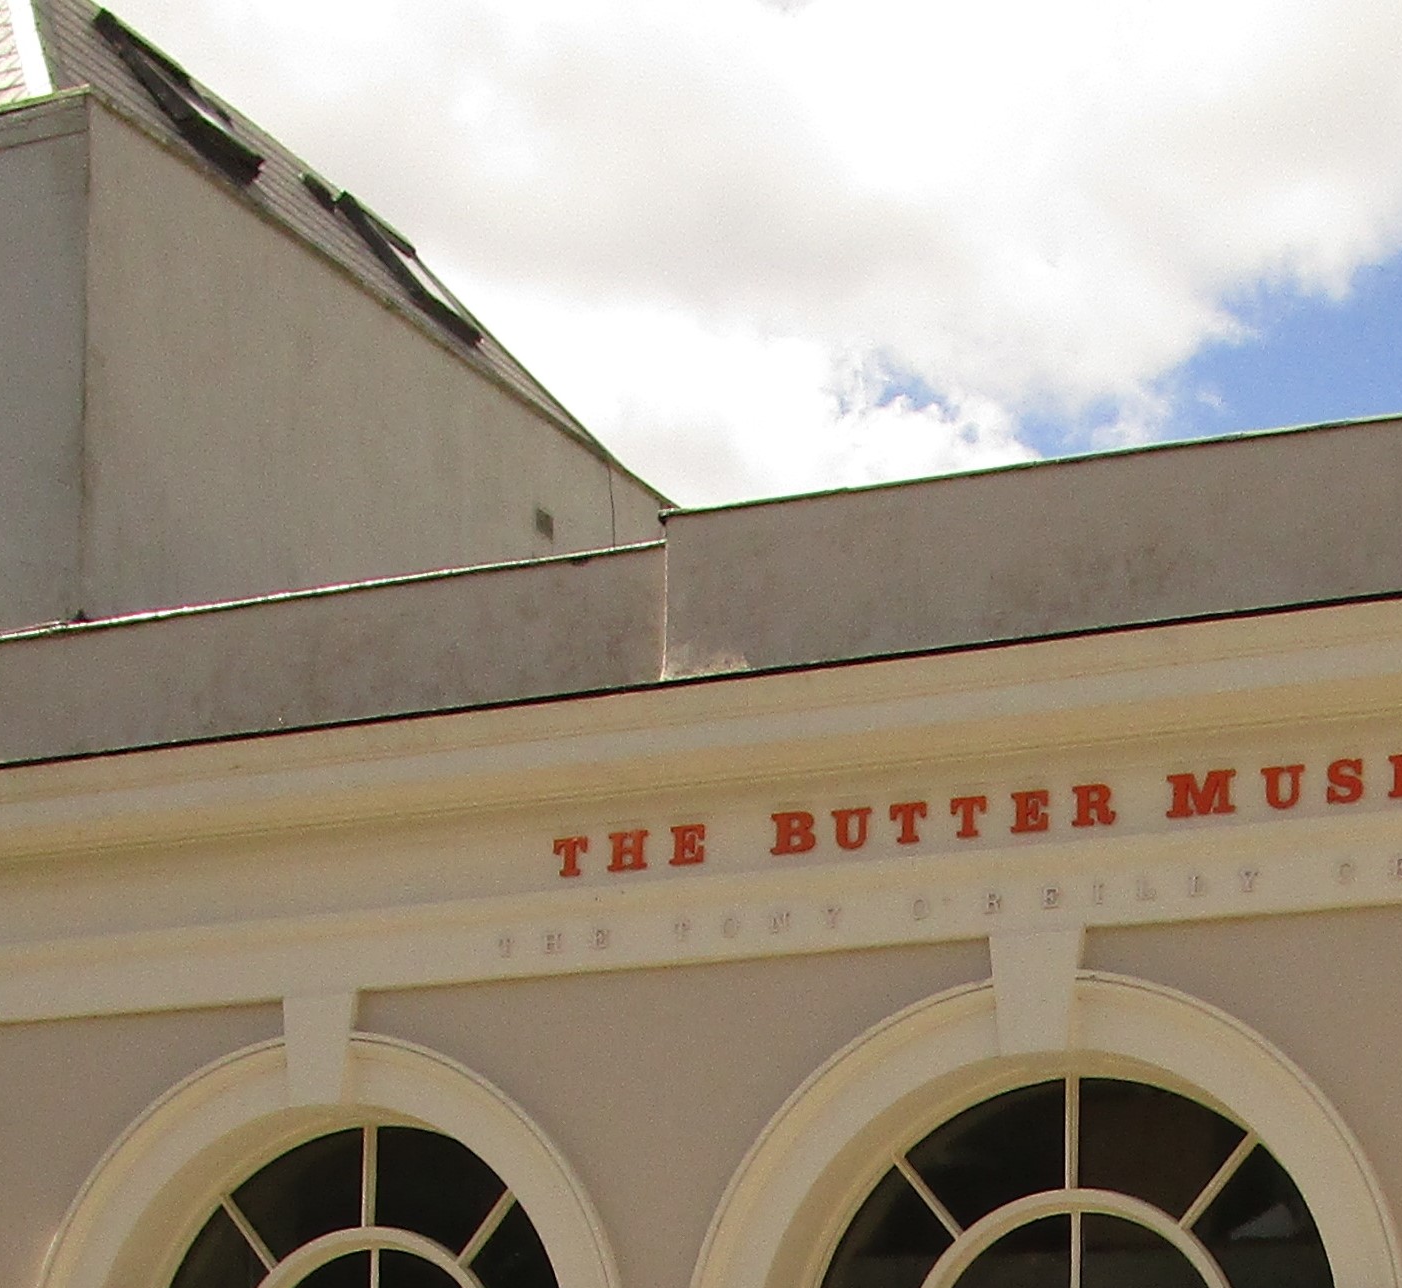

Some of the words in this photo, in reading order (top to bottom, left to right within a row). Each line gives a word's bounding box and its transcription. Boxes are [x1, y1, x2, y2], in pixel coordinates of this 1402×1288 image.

[552, 823, 707, 879] THE
[768, 782, 1117, 858] BUTTER
[497, 927, 612, 960] THE
[673, 905, 841, 941] TONY
